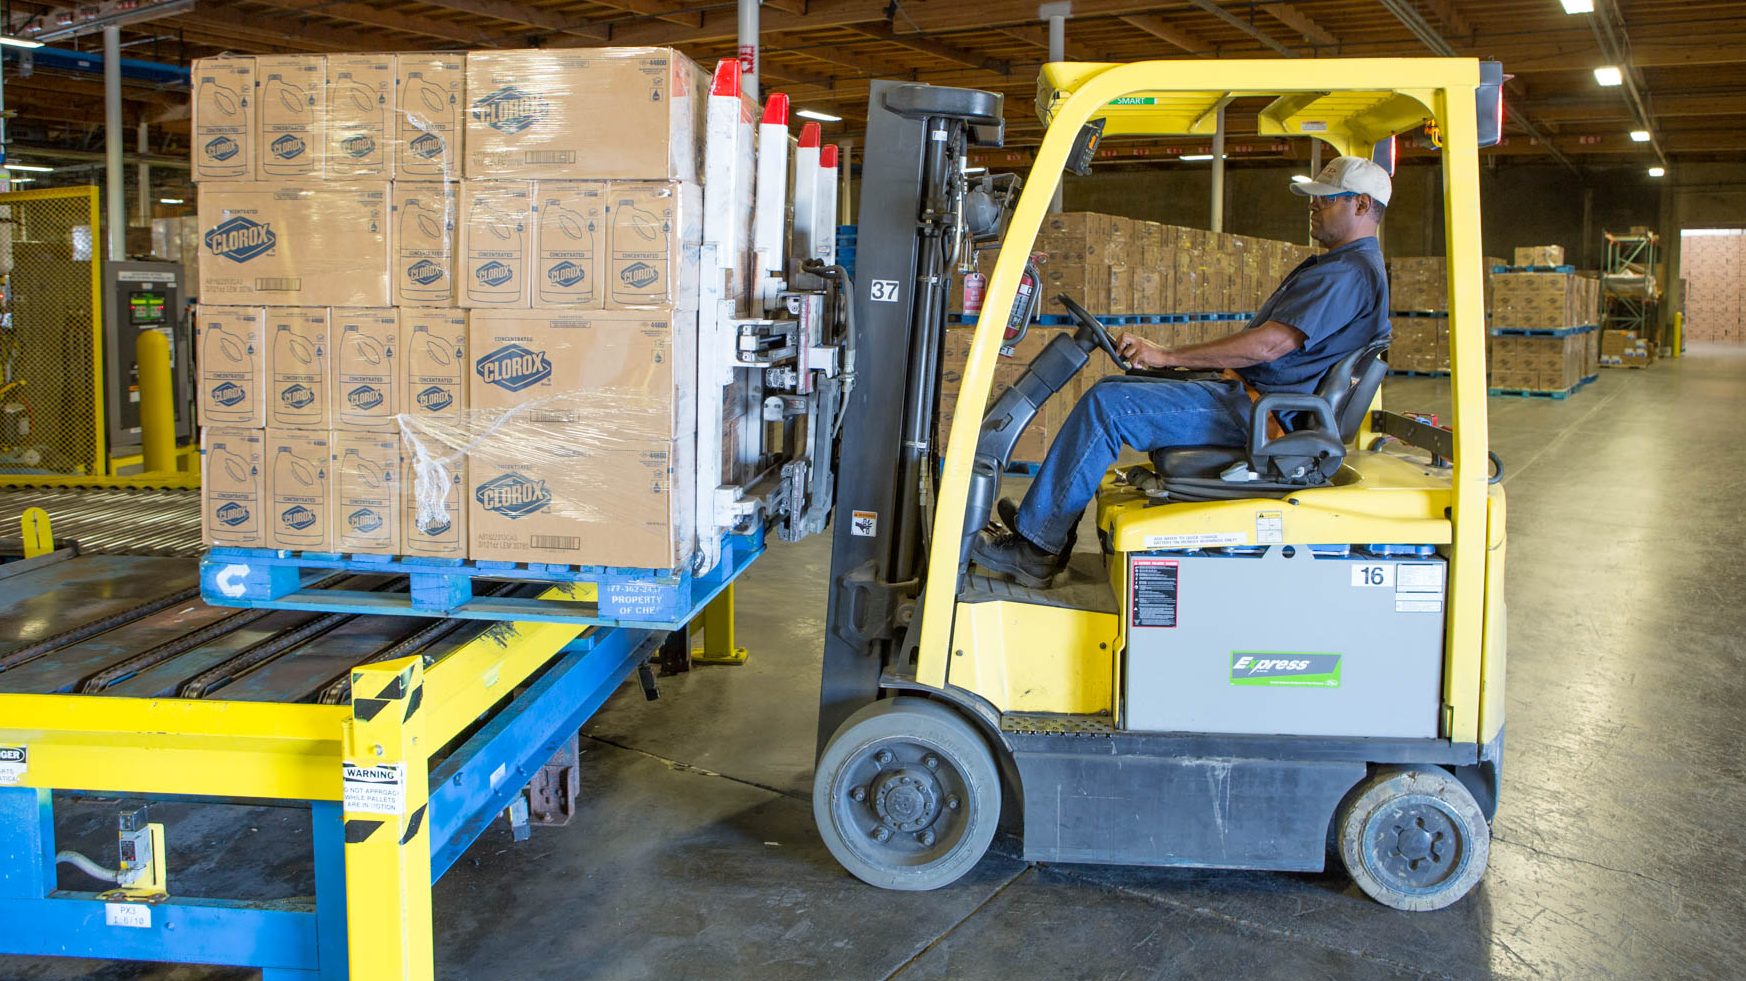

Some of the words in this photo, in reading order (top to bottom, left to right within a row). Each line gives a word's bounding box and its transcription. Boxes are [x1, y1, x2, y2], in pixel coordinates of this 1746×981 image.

[212, 223, 270, 255] CLOROX
[479, 264, 511, 281] CLOROX
[551, 264, 583, 282] CLOROX
[624, 265, 656, 283] CLOROX
[872, 281, 898, 300] 37
[484, 350, 546, 384] CLOROX
[214, 385, 243, 401] CLOROX
[284, 387, 313, 403] CLOROX
[351, 388, 381, 404] CLOROX
[420, 389, 450, 406] CLOROX
[483, 479, 546, 511] CLOROX
[218, 505, 248, 521] CLOROX
[284, 509, 314, 525] CLOROX
[1361, 567, 1384, 585] 16
[612, 595, 663, 604] PROPERTY
[620, 607, 632, 615] OF
[1233, 656, 1309, 676] Express
[346, 769, 395, 780] WARNING
